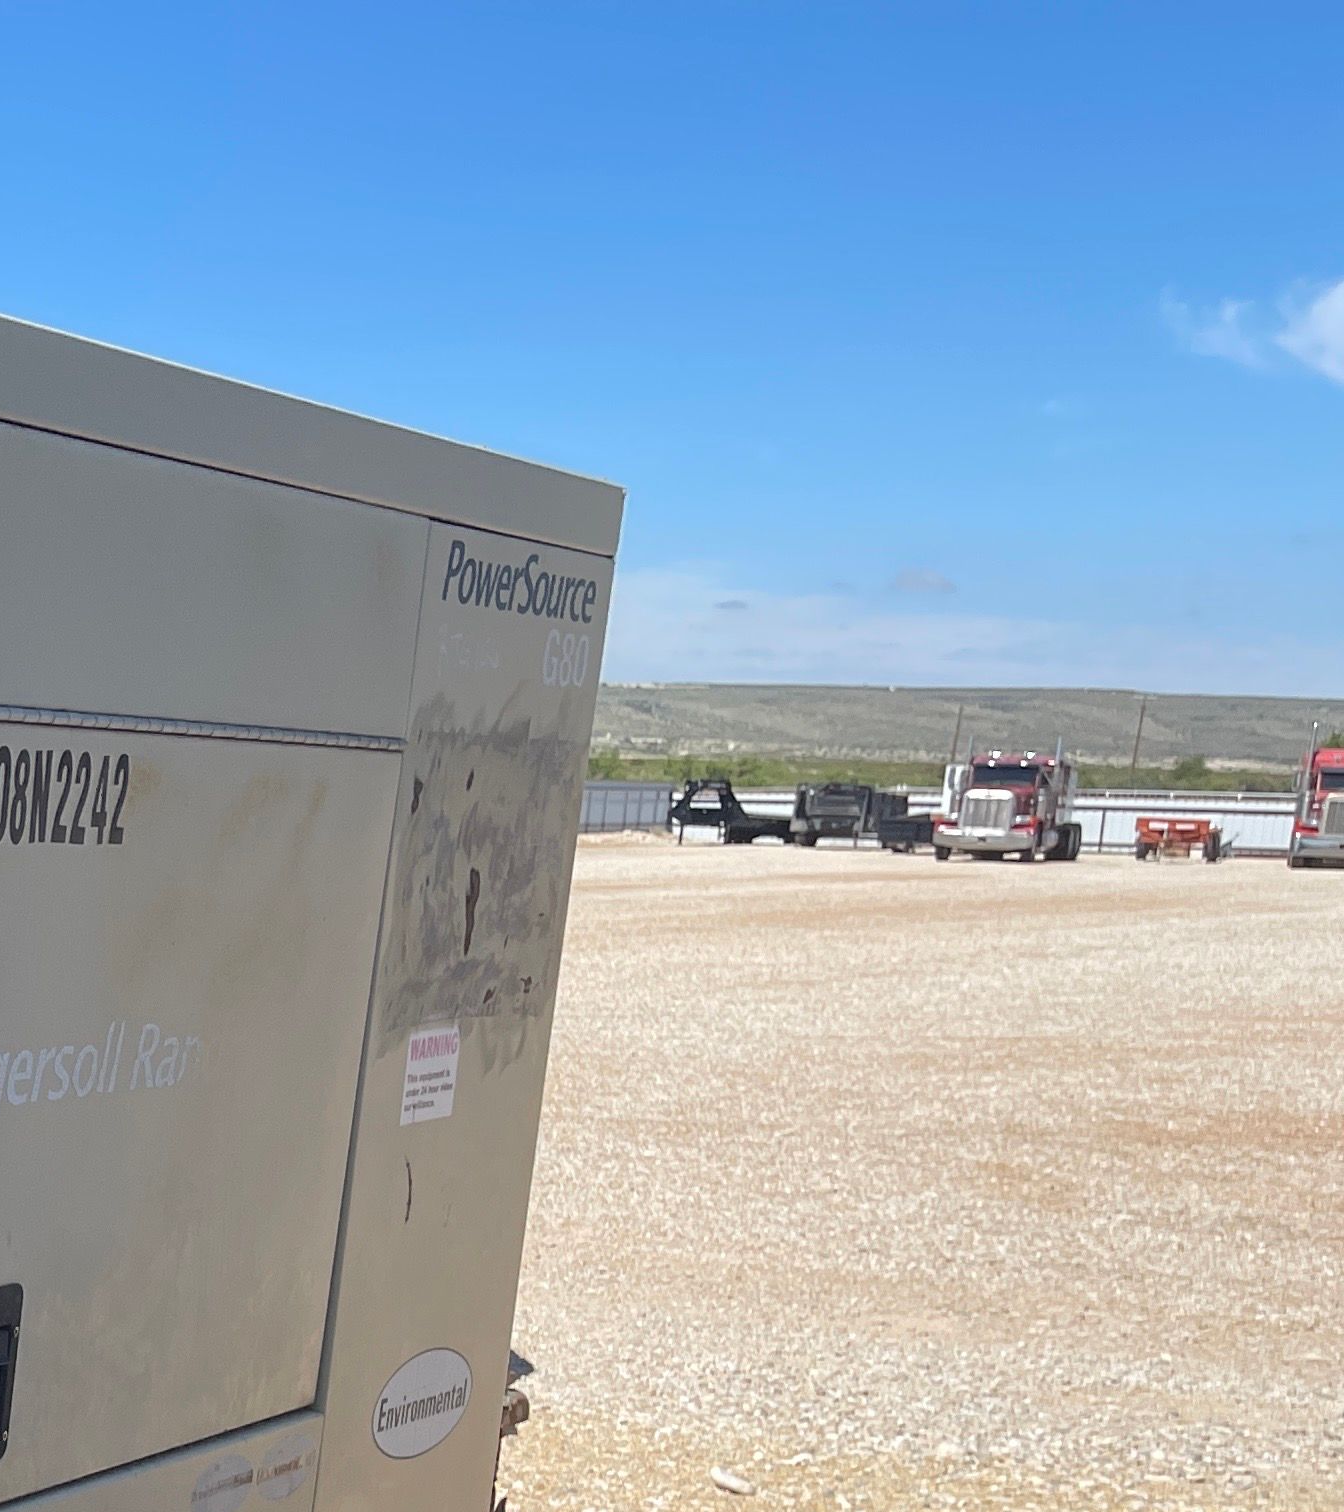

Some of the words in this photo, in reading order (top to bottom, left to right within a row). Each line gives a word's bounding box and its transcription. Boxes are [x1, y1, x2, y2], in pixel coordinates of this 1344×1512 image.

[441, 539, 597, 624] PowerSource
[542, 628, 590, 689] G80
[410, 1032, 459, 1061] WARNING
[376, 1379, 469, 1434] Environmental
